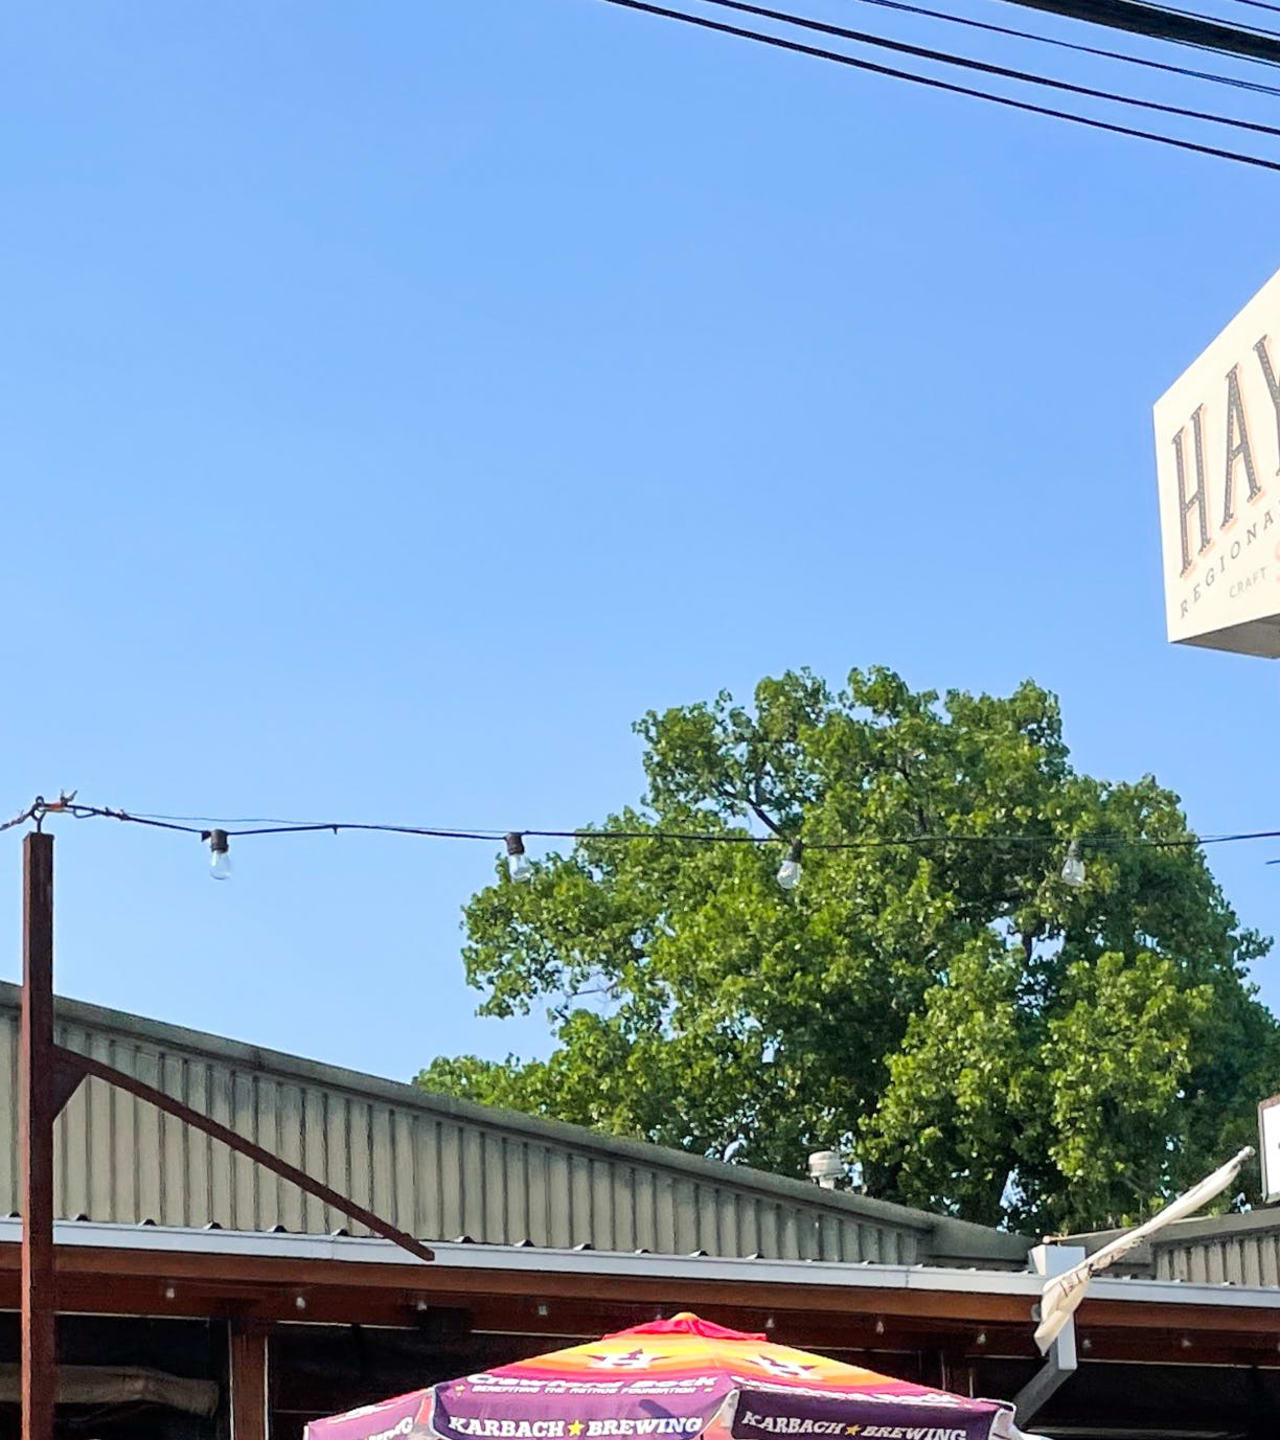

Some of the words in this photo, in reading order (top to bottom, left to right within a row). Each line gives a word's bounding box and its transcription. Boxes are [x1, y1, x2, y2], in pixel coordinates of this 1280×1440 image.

[1228, 566, 1268, 599] CRAFT
[448, 1416, 565, 1438] KARBACH
[586, 1416, 703, 1437] BREWING
[741, 1411, 847, 1436] KARBACH
